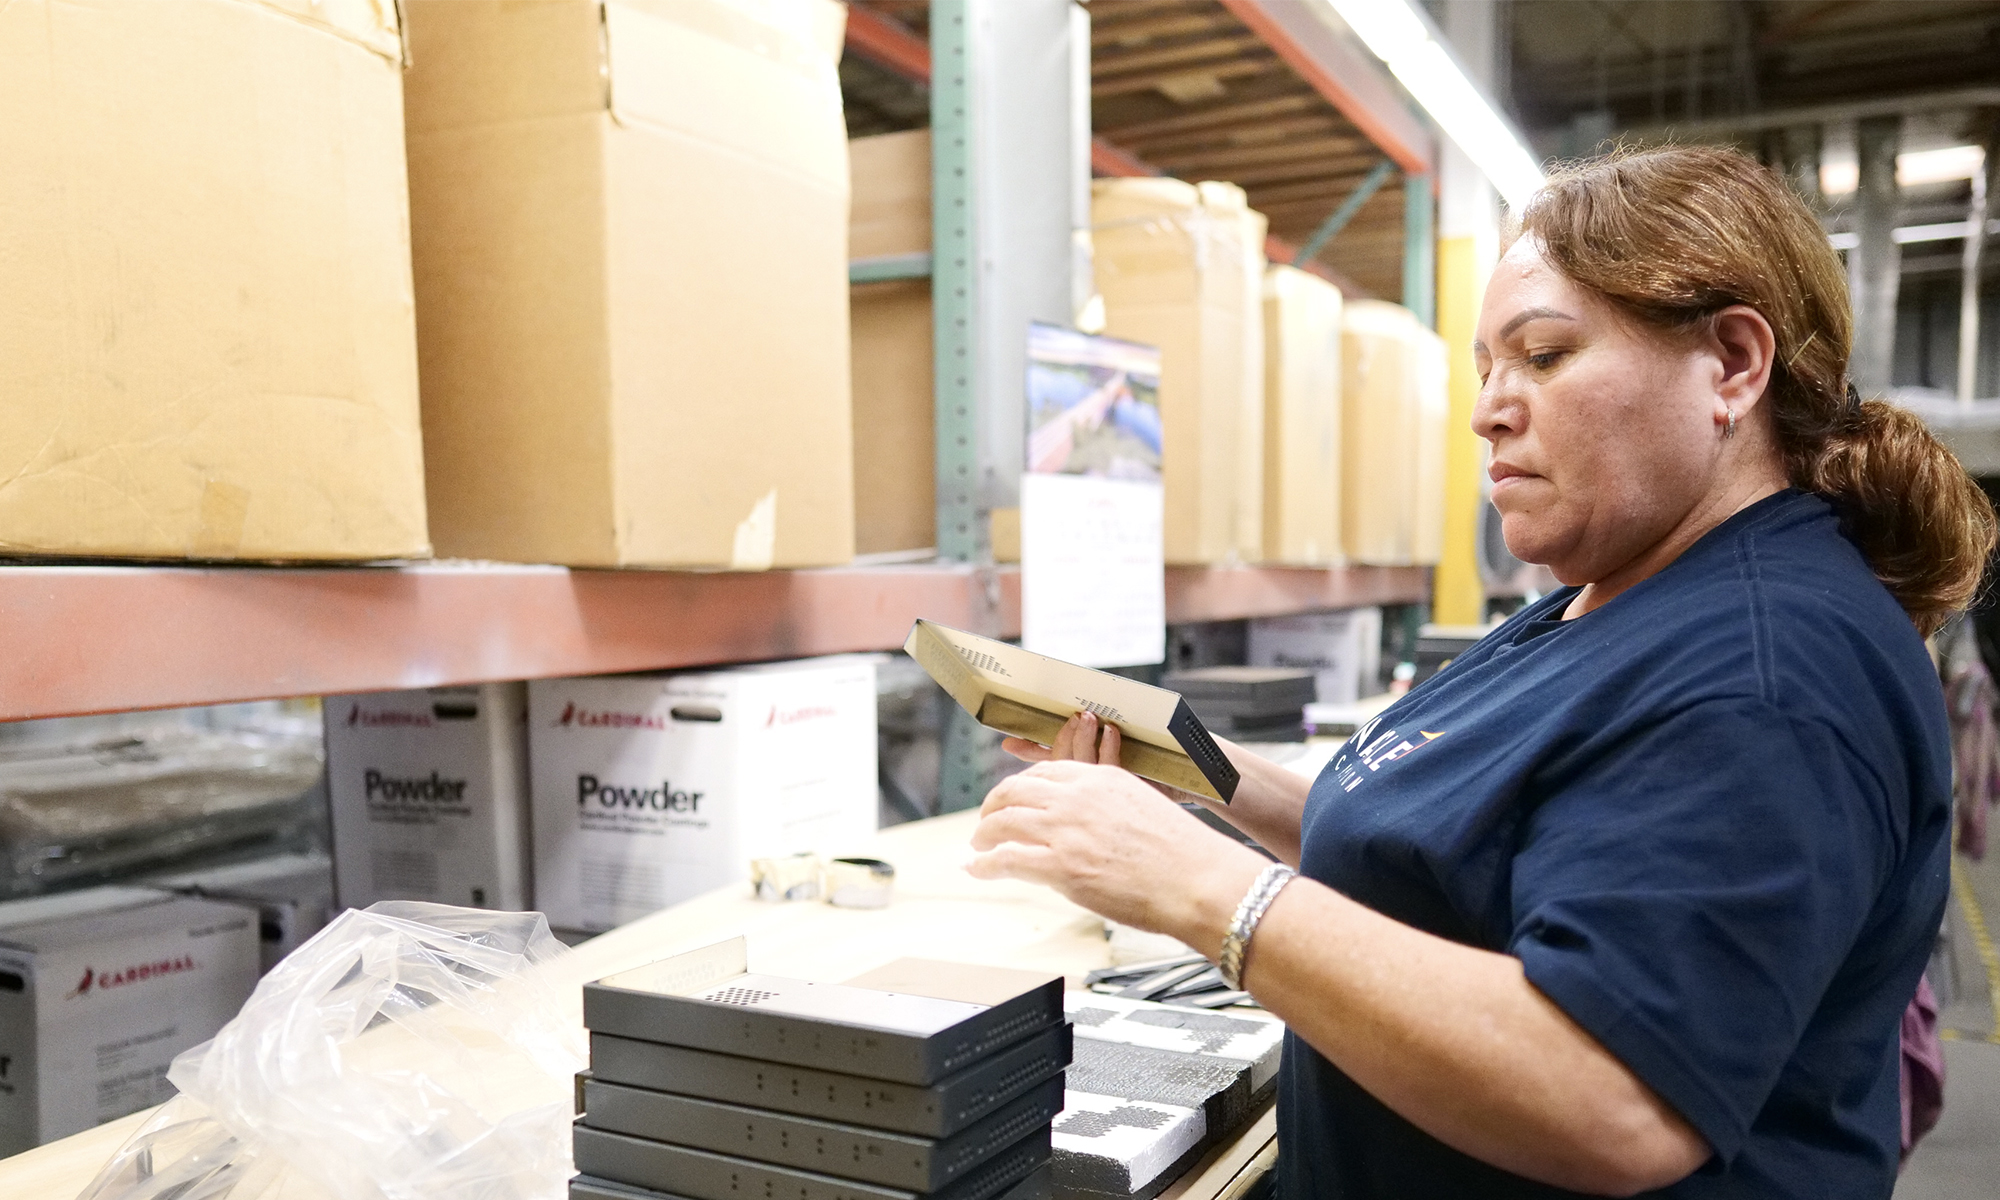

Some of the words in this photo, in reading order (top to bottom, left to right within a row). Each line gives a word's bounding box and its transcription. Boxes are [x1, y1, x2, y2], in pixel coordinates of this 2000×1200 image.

[578, 709, 664, 731] CARDINAL
[365, 768, 466, 801] Powder
[577, 773, 704, 812] Powder
[98, 954, 194, 989] CARDINAL
